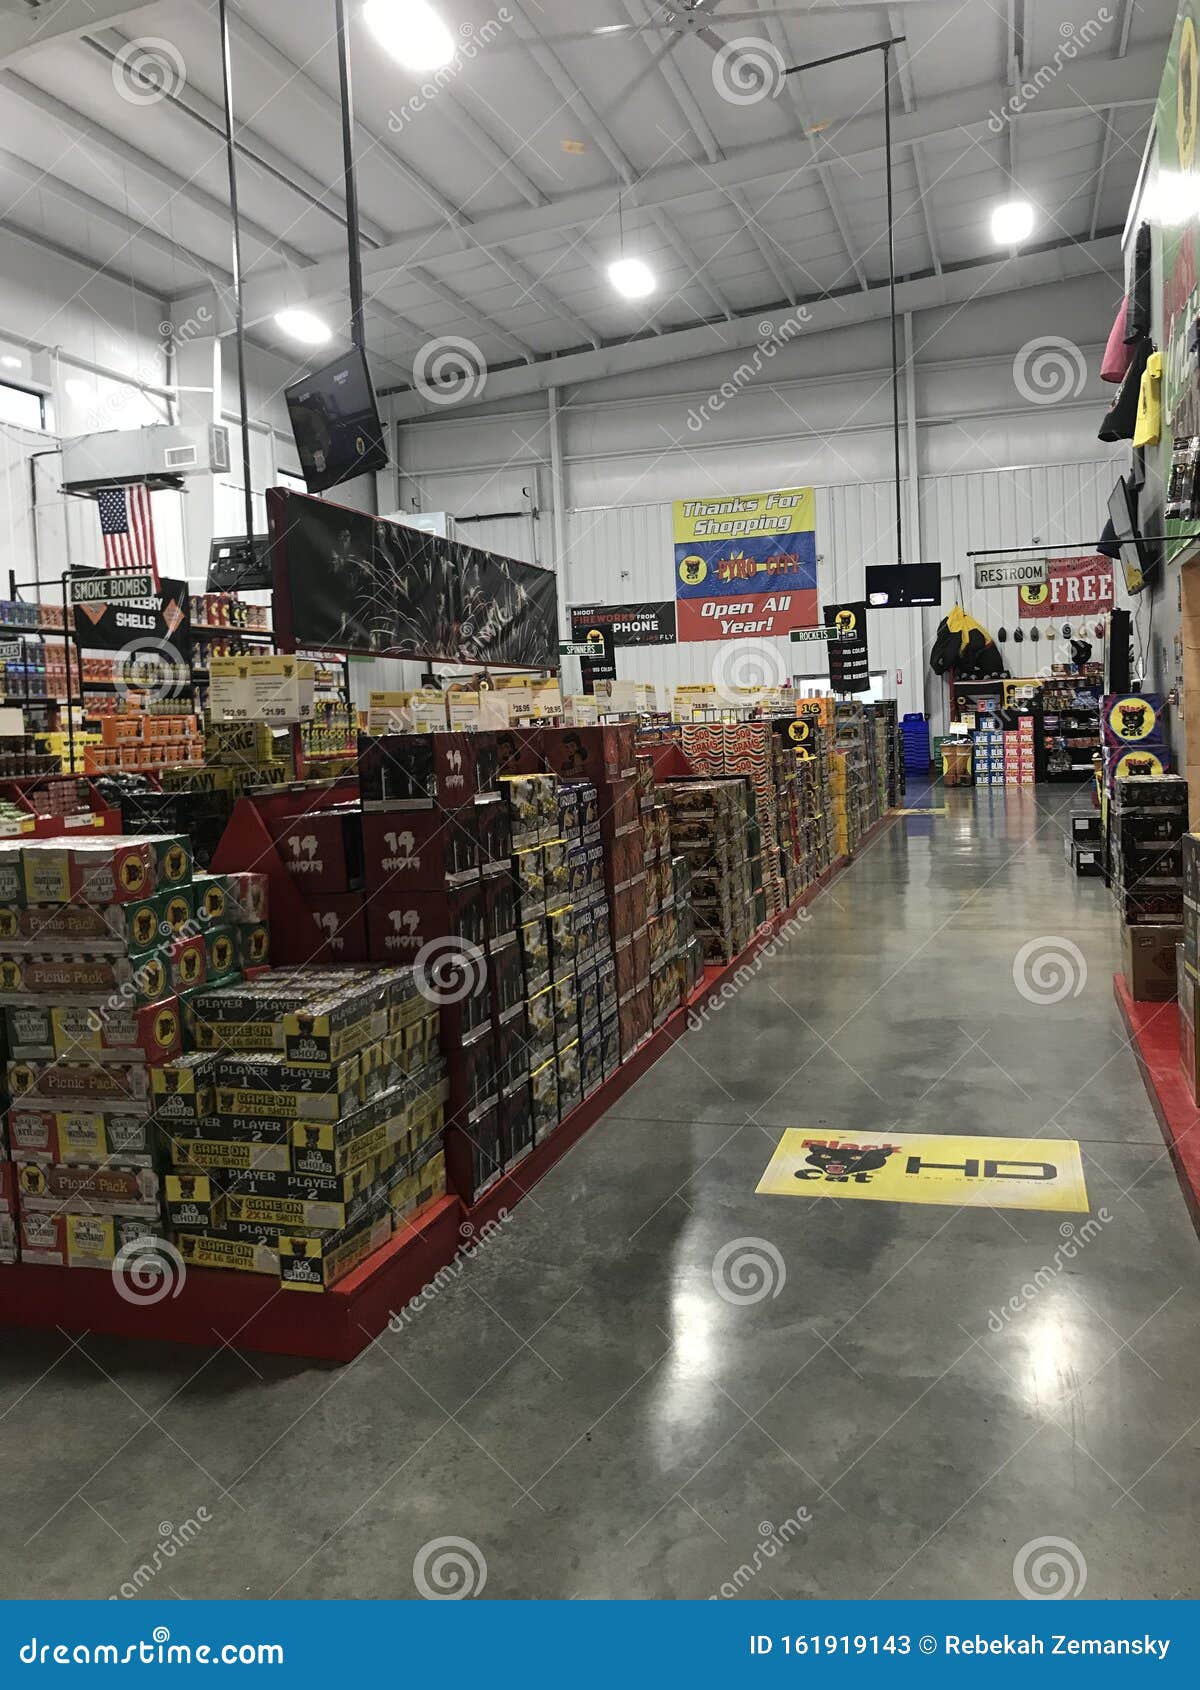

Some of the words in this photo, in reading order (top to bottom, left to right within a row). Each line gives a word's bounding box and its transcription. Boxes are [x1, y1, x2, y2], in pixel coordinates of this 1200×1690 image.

[683, 498, 760, 517] Thanks
[766, 493, 803, 510] For
[694, 514, 793, 536] Shopping
[717, 556, 758, 580] PYRO
[765, 553, 800, 575] CITY
[980, 565, 1043, 583] RESTROOM
[74, 580, 108, 600] SMOKE
[110, 578, 148, 597] BOMBS
[1049, 574, 1113, 603] FREE
[701, 602, 754, 619] Open
[761, 596, 792, 613] All
[115, 612, 156, 630] SHELLS
[613, 620, 659, 633] PHONE
[720, 617, 774, 634] Year!
[659, 633, 674, 641] FLY
[799, 630, 829, 641] ROCKETS
[566, 644, 596, 655] SPINNERS
[222, 708, 248, 717] $22.95
[261, 707, 286, 716] $21.95
[801, 703, 821, 714] 16
[1118, 705, 1148, 713] Black
[691, 739, 718, 754] GRAMS
[732, 738, 760, 753] GRAMS
[288, 834, 319, 861] 19
[383, 830, 416, 858] 19
[381, 856, 421, 873] SHOTS
[29, 916, 66, 930] Picnic
[67, 916, 98, 930] Pack
[388, 910, 420, 936] 19
[385, 935, 424, 948] SHOTS
[34, 970, 71, 984] Picnic
[73, 970, 105, 985] Pack
[197, 1000, 243, 1009] PLAYER
[217, 1009, 225, 1020] 1
[220, 1064, 269, 1077] PLAYER
[280, 1067, 331, 1079] PLAYER
[48, 1075, 85, 1090] Picnic
[88, 1077, 119, 1090] Pack
[240, 1076, 251, 1088] 1
[300, 1078, 313, 1091] 2
[237, 1092, 273, 1105] GAME
[274, 1094, 297, 1107] ON
[268, 1106, 298, 1116] SHOTS
[232, 1119, 281, 1131] PLAYER
[193, 1126, 204, 1139] 1
[251, 1130, 263, 1142] 2
[192, 1143, 228, 1156] GAME
[228, 1144, 250, 1157] ON
[802, 1139, 903, 1153] Black
[222, 1157, 250, 1167] SHOTS
[298, 1160, 333, 1172] SHOTS
[905, 1156, 1058, 1181] HD
[228, 1169, 277, 1181] PLAYER
[287, 1176, 337, 1189] PLAYER
[793, 1167, 876, 1184] Cat
[58, 1176, 96, 1191] Picnic
[99, 1178, 129, 1193] Pack
[248, 1181, 258, 1193] 1
[307, 1188, 319, 1200] 2
[180, 1203, 199, 1216] 16
[246, 1198, 284, 1211] GAME
[284, 1201, 304, 1214] ON
[171, 1213, 209, 1225] SHOTS
[275, 1213, 305, 1224] SHOTS
[199, 1238, 234, 1252] GAME
[234, 1243, 254, 1257] ON
[258, 1235, 268, 1247] 2
[226, 1255, 255, 1268] SHOTS
